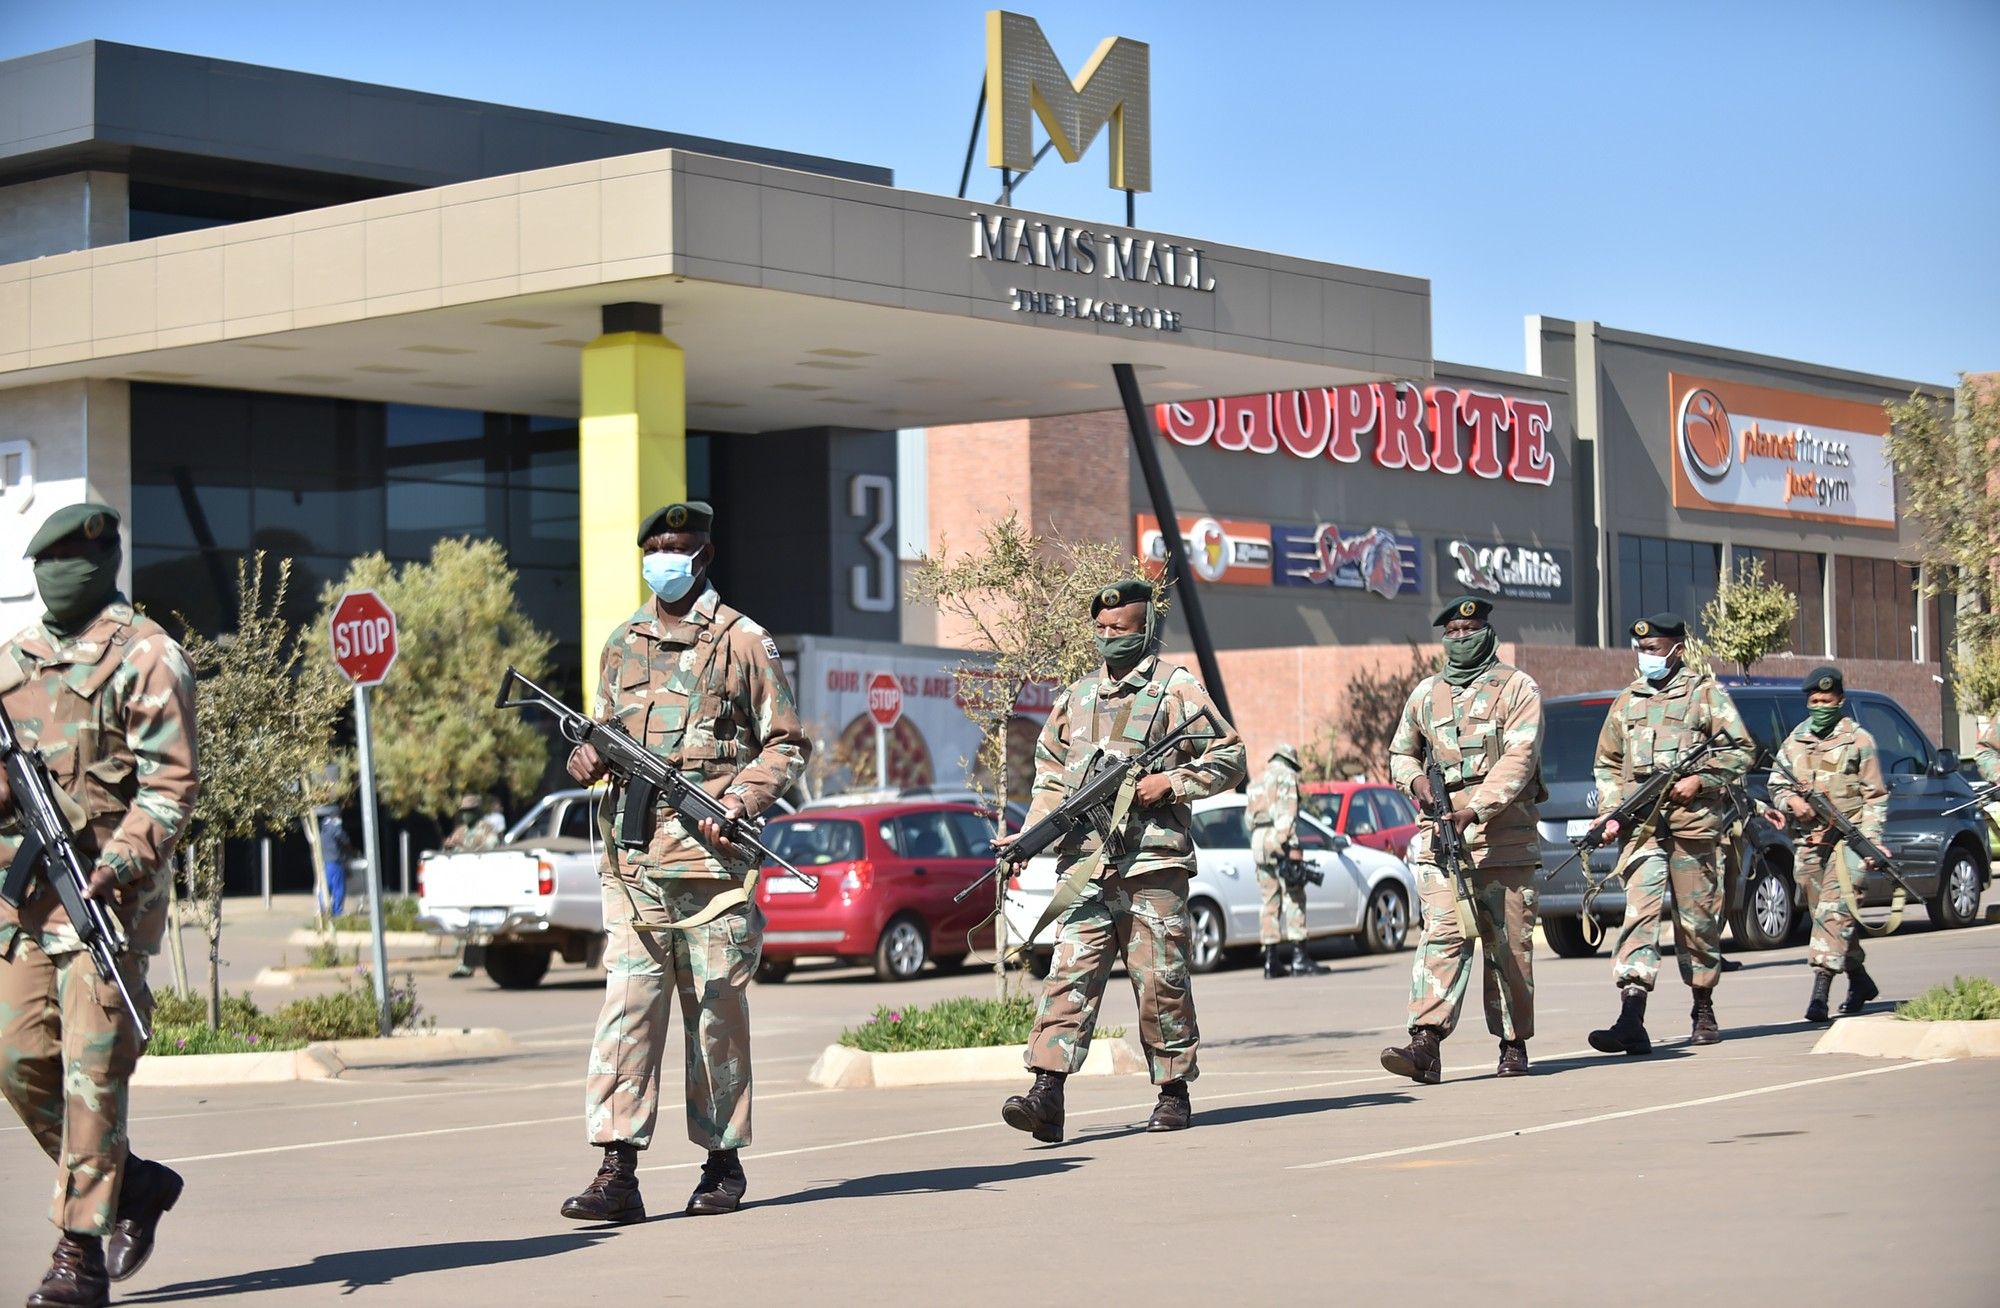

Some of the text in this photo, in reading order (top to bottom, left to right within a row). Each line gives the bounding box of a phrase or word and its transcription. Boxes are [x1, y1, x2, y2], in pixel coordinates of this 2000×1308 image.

[985, 9, 1152, 194] M
[969, 211, 1217, 293] MAMS MALL
[1008, 287, 1183, 333] THE PLACE TO BE
[851, 474, 895, 612] 3
[336, 616, 391, 660] STOP
[827, 669, 860, 694] OUR
[870, 688, 899, 711] STOP
